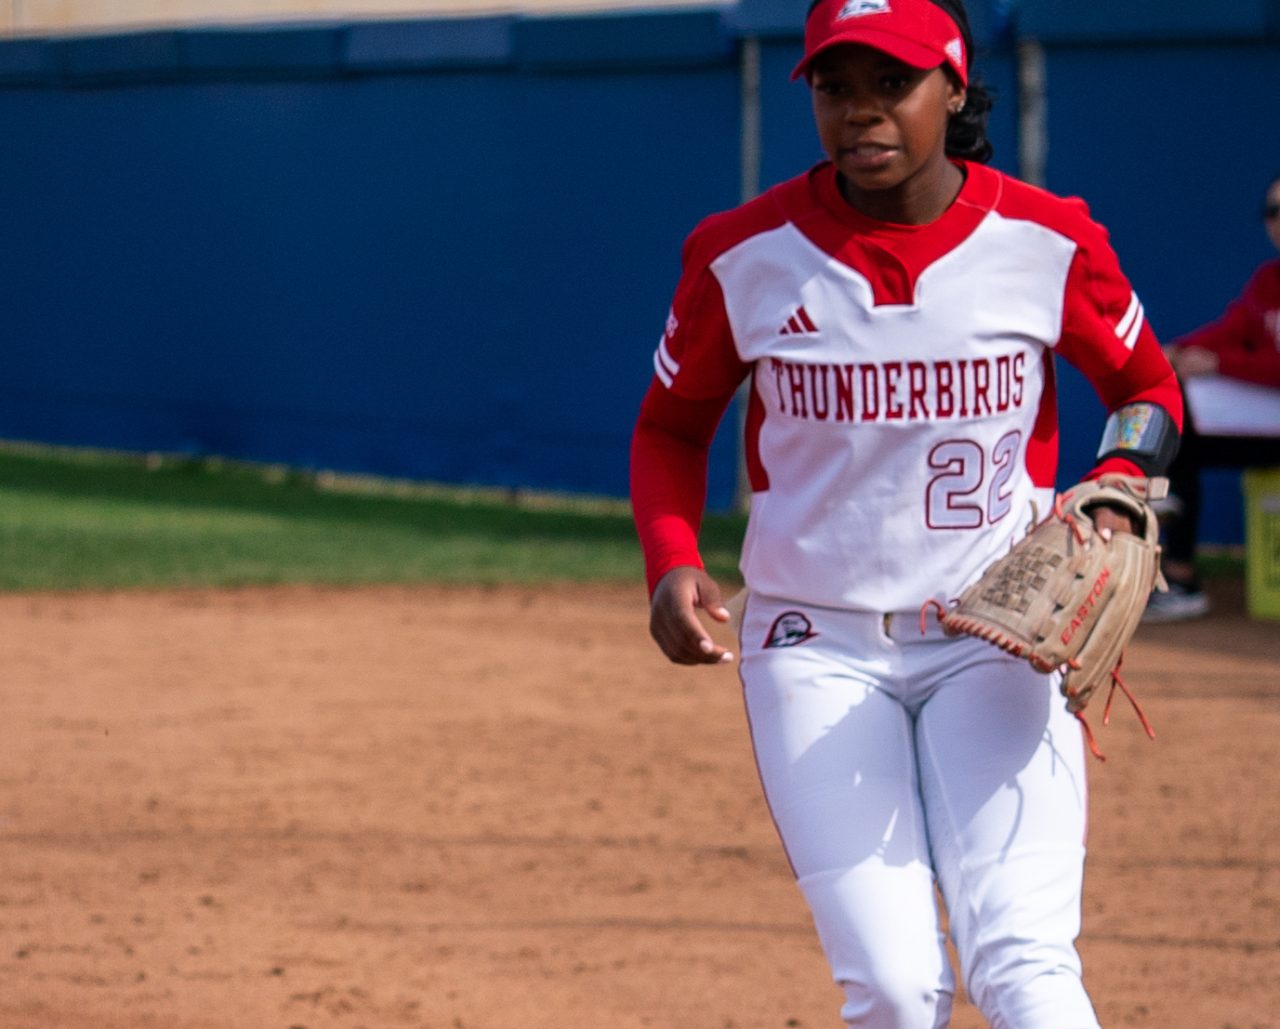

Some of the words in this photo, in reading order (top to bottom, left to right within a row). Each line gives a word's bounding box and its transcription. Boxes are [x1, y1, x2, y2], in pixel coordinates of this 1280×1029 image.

[771, 352, 1024, 421] THUNDERBIRDS
[926, 429, 1021, 529] 22
[1060, 566, 1111, 646] EASTON
